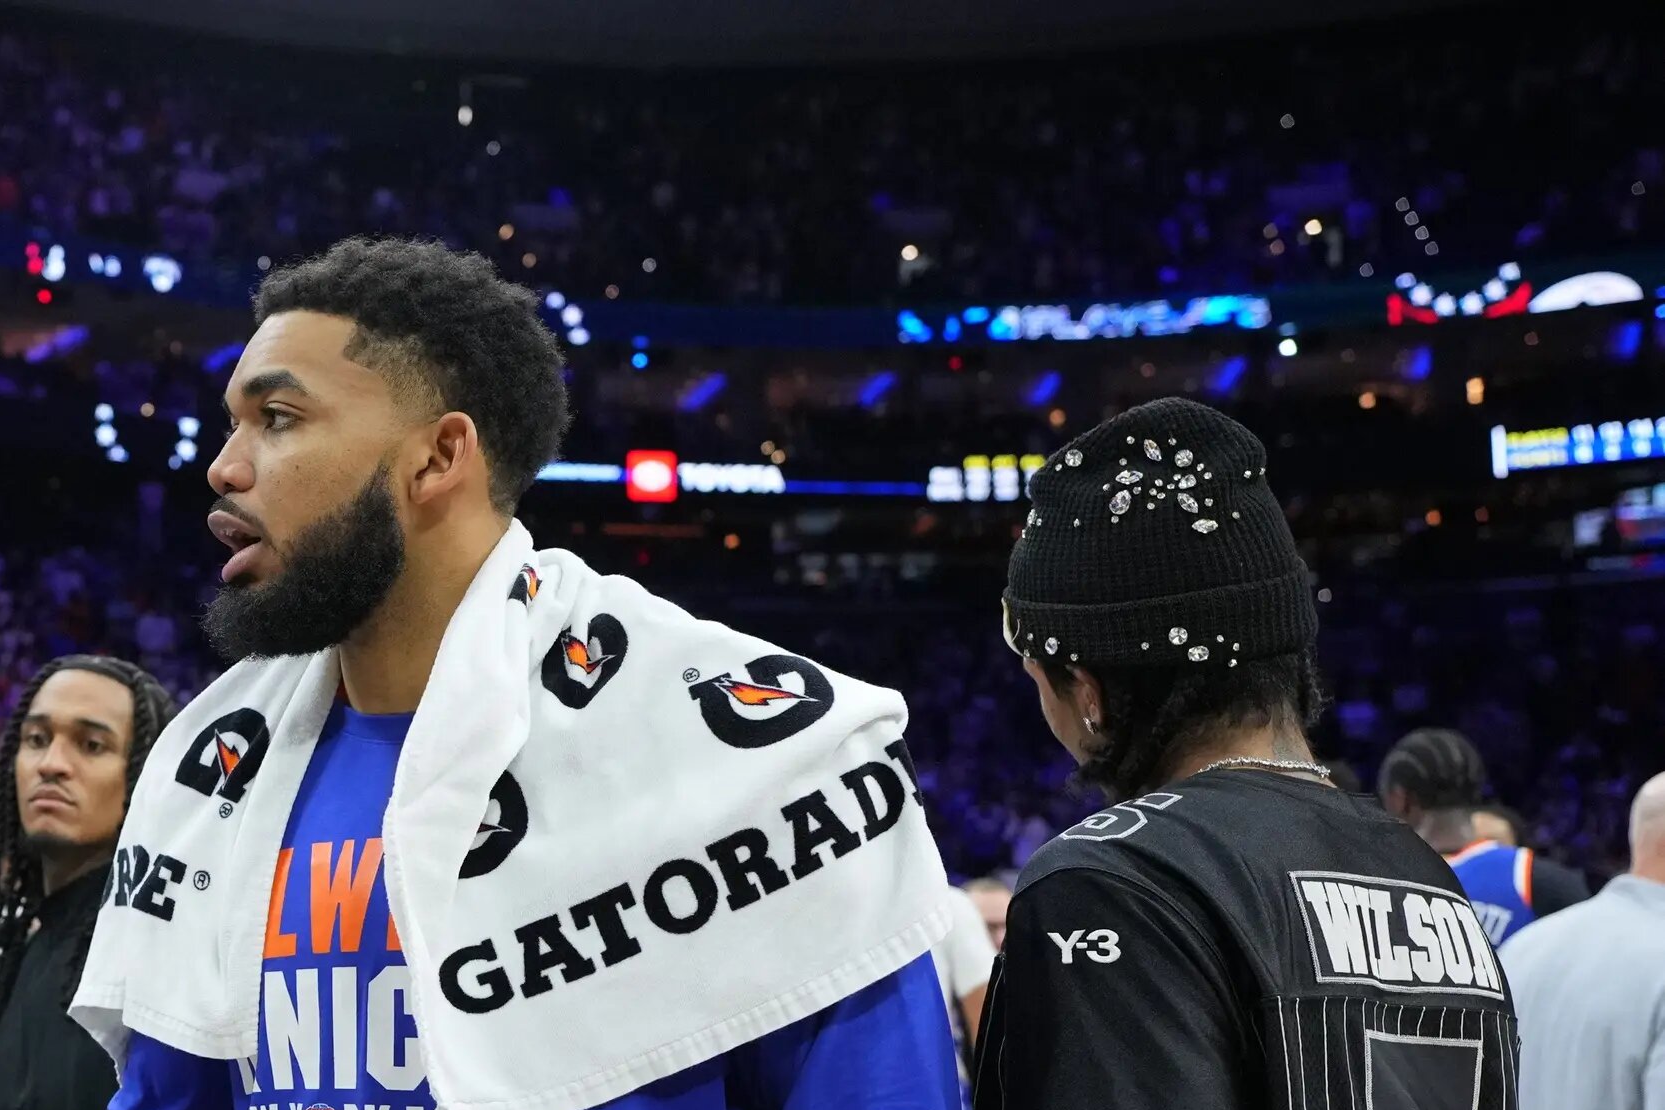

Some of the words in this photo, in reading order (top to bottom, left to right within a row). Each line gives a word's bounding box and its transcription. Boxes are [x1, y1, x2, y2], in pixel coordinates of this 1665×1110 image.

[677, 462, 785, 494] TOYOTA
[1047, 928, 1122, 964] Y-3
[1300, 878, 1501, 992] WILSON
